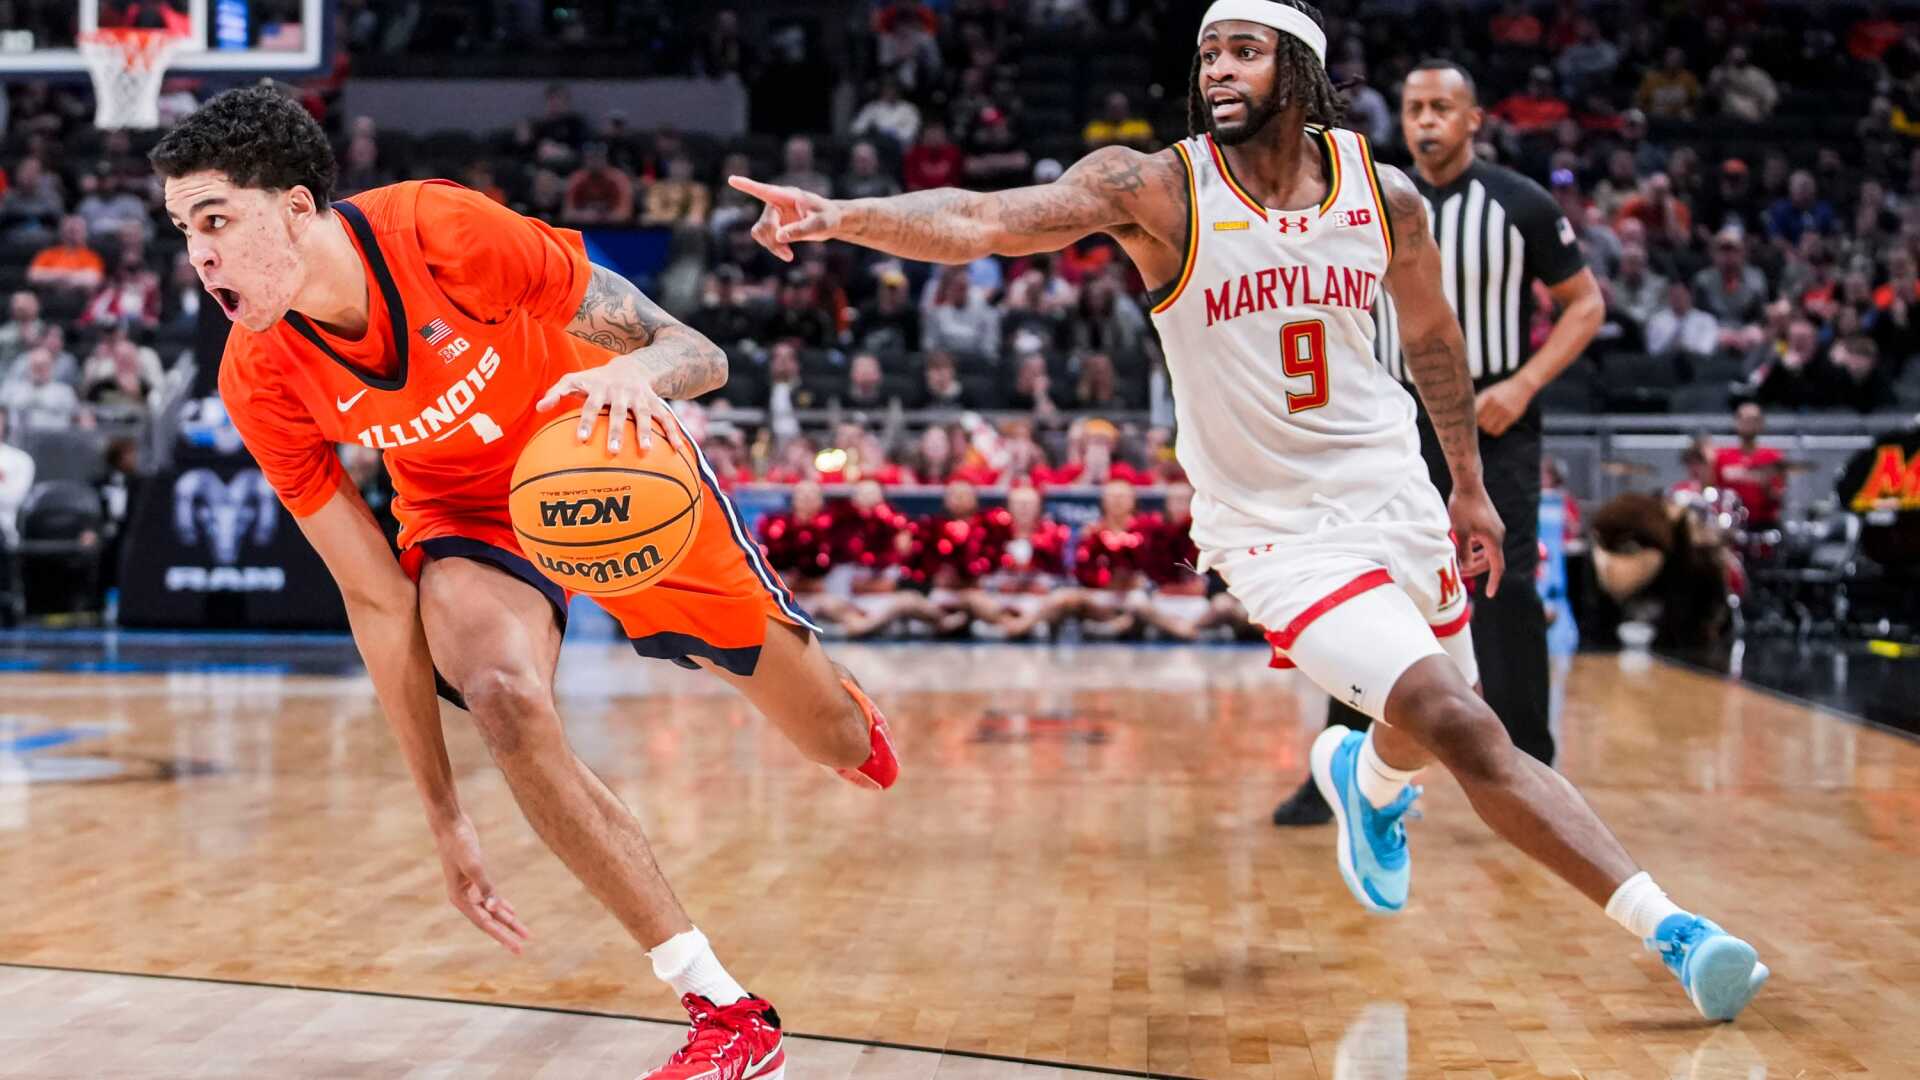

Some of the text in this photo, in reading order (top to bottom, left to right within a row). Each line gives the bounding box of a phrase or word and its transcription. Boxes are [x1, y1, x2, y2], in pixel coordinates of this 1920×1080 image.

[1204, 265, 1376, 327] MARYLAND
[1279, 319, 1329, 414] 9
[358, 346, 501, 449] ILLINOIS
[539, 494, 632, 527] NCAA
[165, 566, 286, 592] RAM
[535, 544, 665, 584] Wilson
[1436, 557, 1461, 610] M
